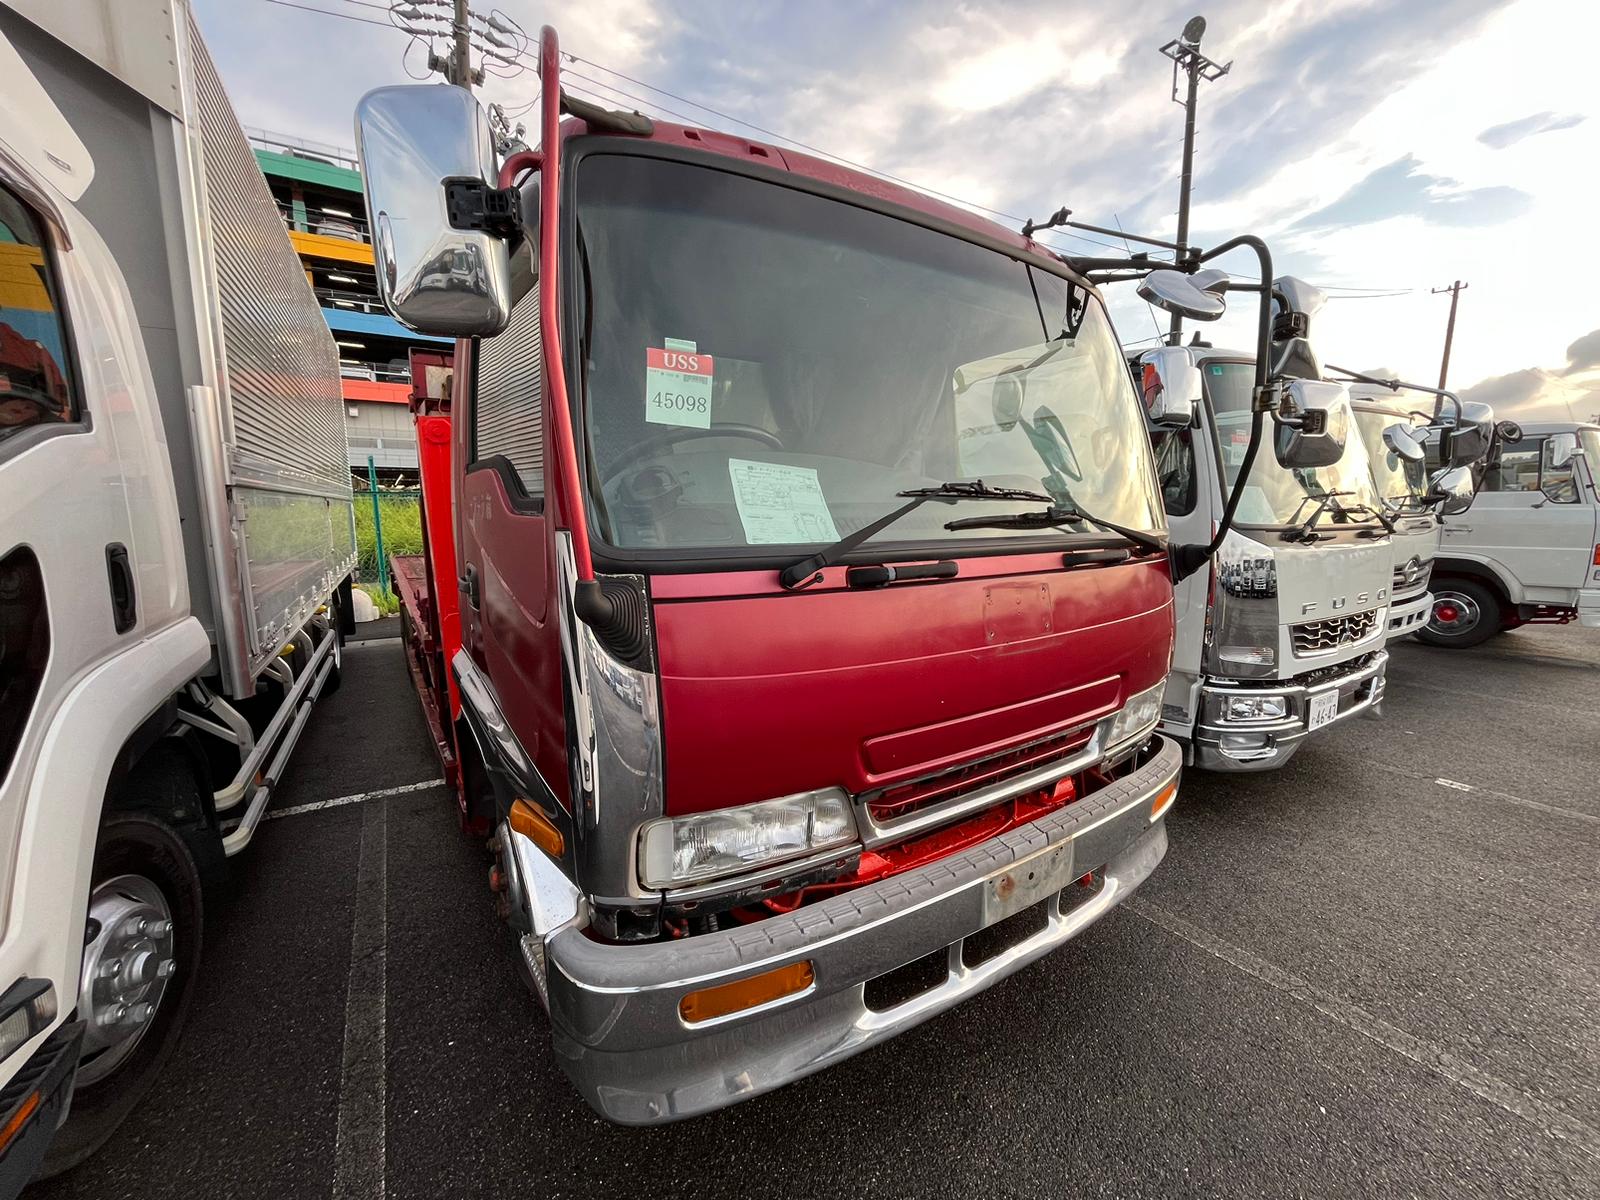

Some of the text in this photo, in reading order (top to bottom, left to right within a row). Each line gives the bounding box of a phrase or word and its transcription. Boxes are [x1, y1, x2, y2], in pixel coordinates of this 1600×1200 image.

[663, 352, 699, 371] USS
[652, 391, 708, 414] 45098
[1301, 587, 1387, 616] FUSO
